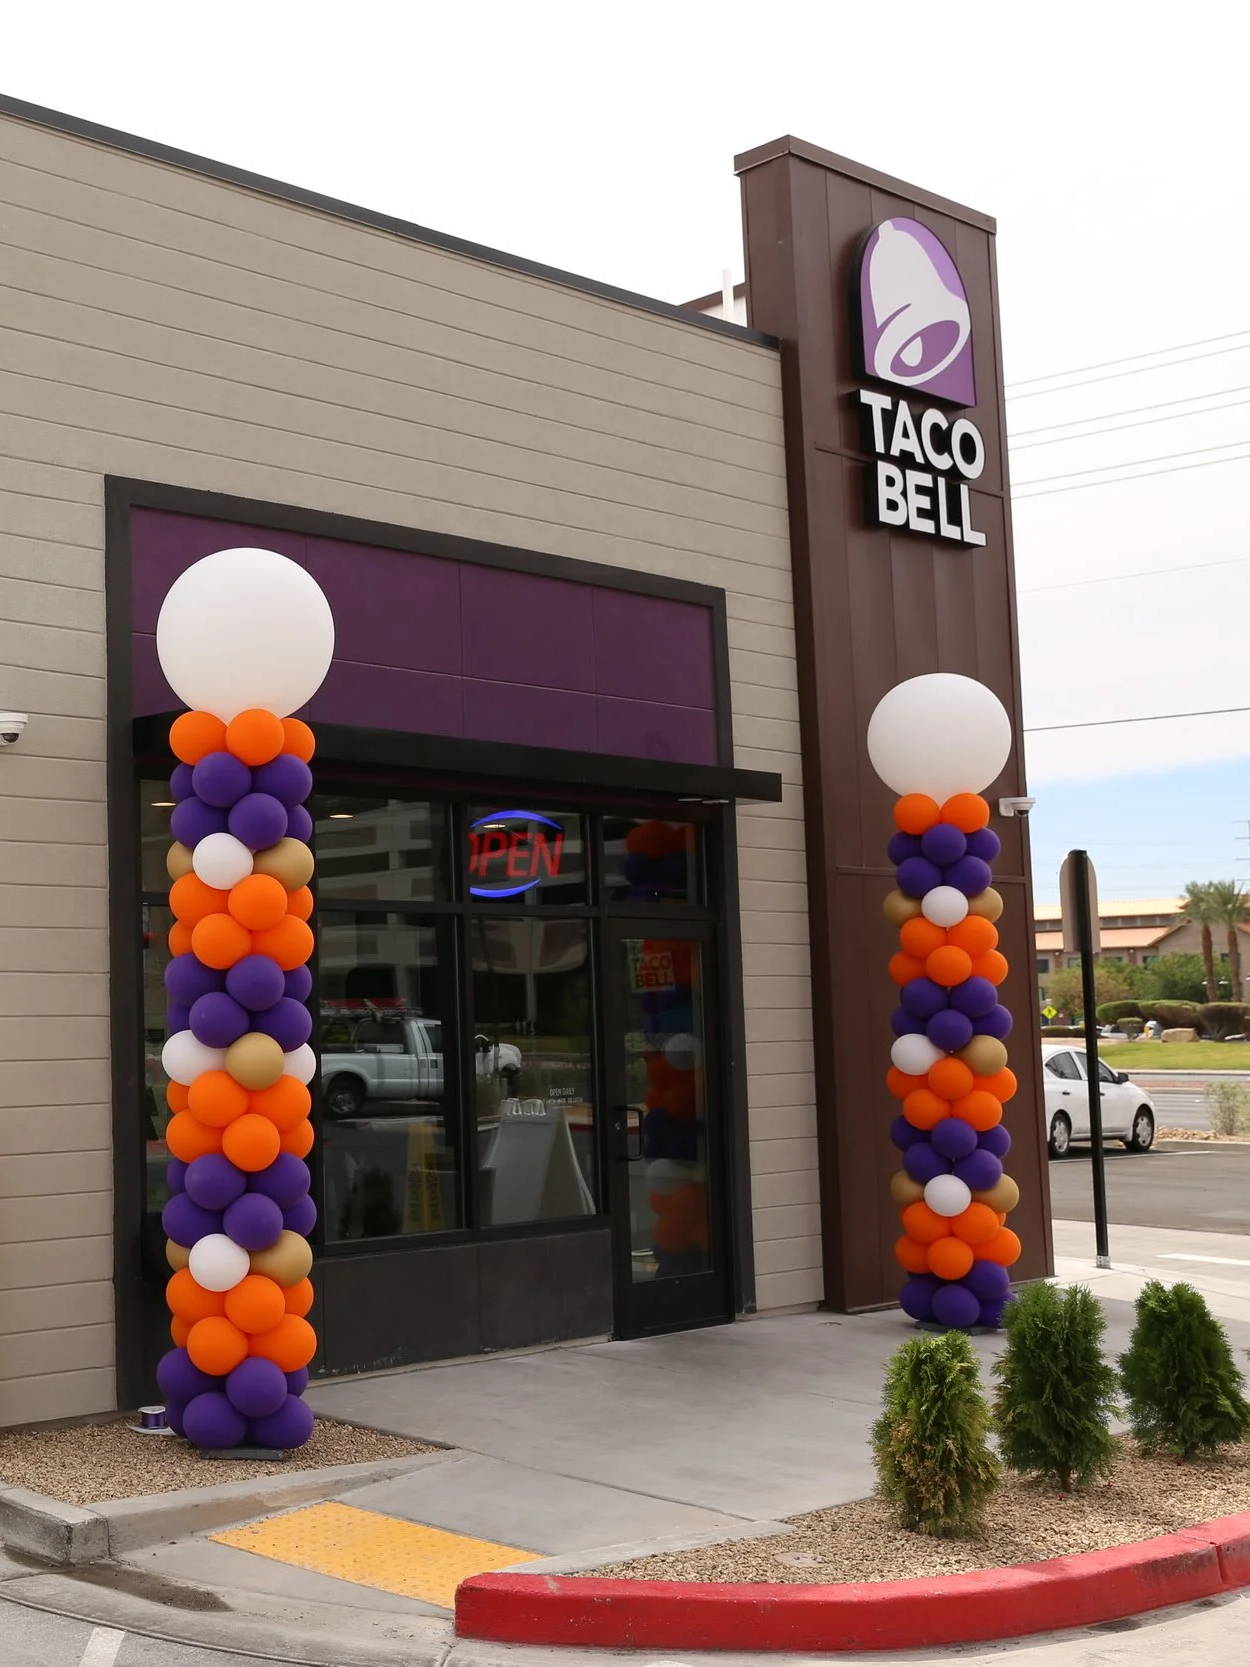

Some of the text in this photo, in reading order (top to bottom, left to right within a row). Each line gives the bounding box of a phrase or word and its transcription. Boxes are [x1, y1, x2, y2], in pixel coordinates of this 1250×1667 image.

[859, 389, 986, 480] TACO
[877, 460, 987, 546] BELL
[630, 955, 671, 971] TACO
[635, 971, 673, 988] BELL
